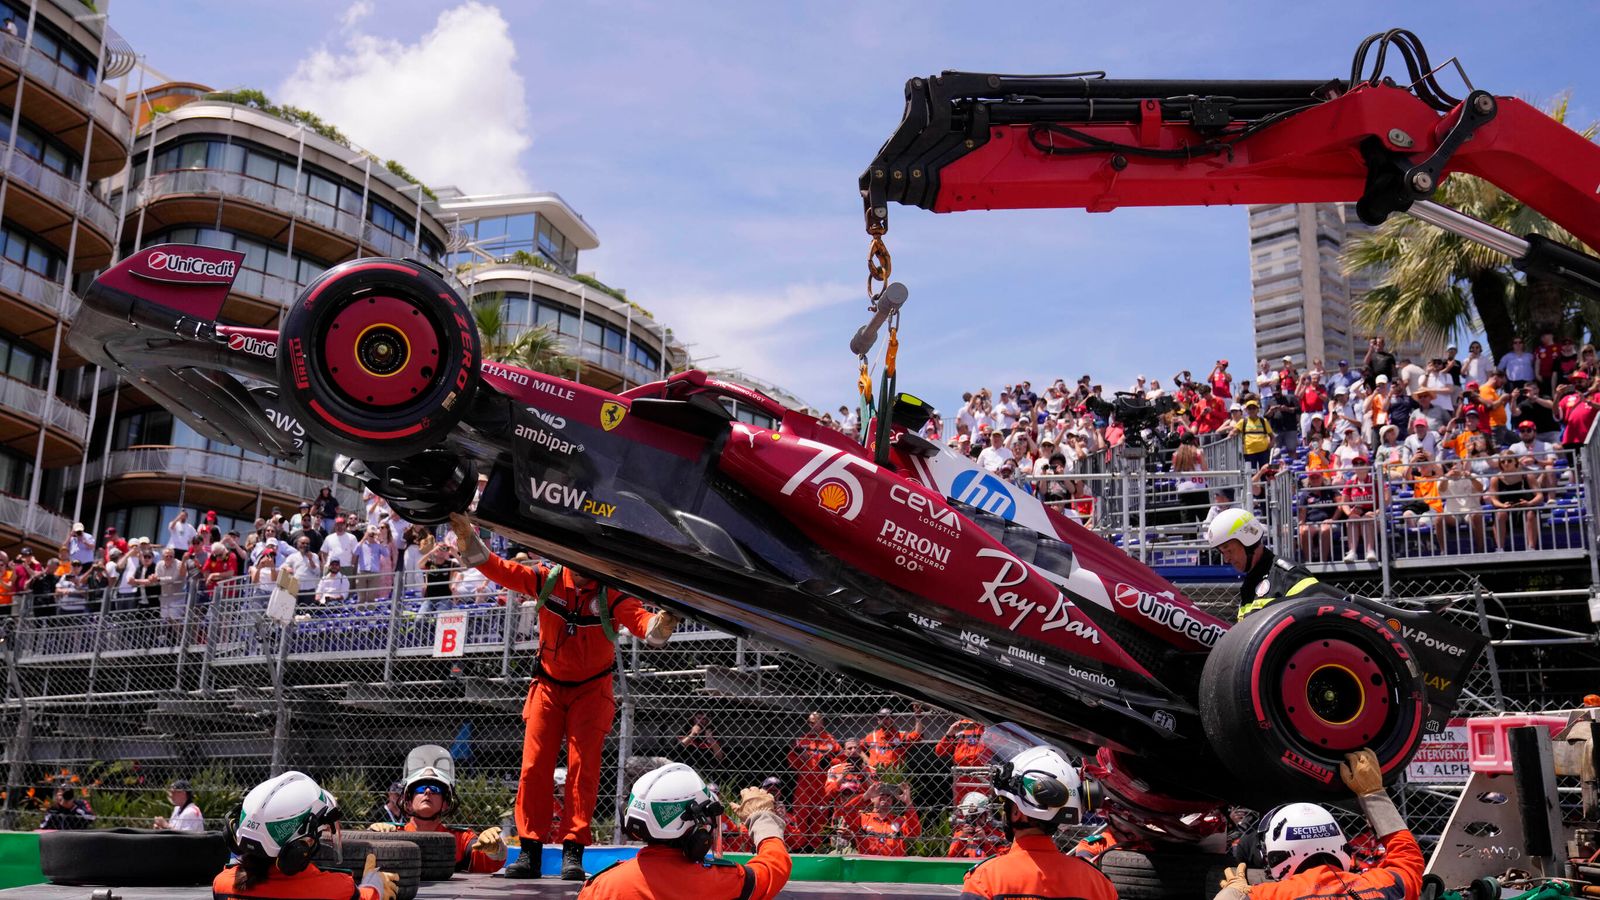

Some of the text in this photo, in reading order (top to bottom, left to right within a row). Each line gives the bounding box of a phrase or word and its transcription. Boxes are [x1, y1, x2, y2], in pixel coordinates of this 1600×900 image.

[167, 253, 235, 277] UniCredit
[243, 336, 278, 358] UniCr
[453, 311, 473, 390] ZERO
[480, 362, 576, 401] CHARD MILLE
[530, 477, 616, 518] VGW PLAY
[957, 470, 1012, 517] hp
[918, 516, 960, 539] LOGISTICS
[880, 518, 951, 564] PERONI
[876, 537, 945, 571] NASTRO AZZURRO
[907, 612, 942, 629] SKF
[1138, 591, 1227, 648] UniCredi
[441, 629, 457, 653] B
[960, 629, 990, 648] NGK
[1317, 605, 1410, 660] P ZERO
[1402, 625, 1466, 657] V-Power
[1007, 645, 1046, 666] MAHLE
[1068, 665, 1116, 688] brembo
[1423, 672, 1451, 691] LAY
[1153, 713, 1174, 732] FIA
[1424, 731, 1456, 742] TEUR
[1414, 749, 1471, 761] NTERVENTI
[1416, 763, 1471, 776] 4 ALPH
[247, 819, 260, 831] 267
[1293, 825, 1327, 835] SECTEUR
[1300, 832, 1331, 840] BRAVO
